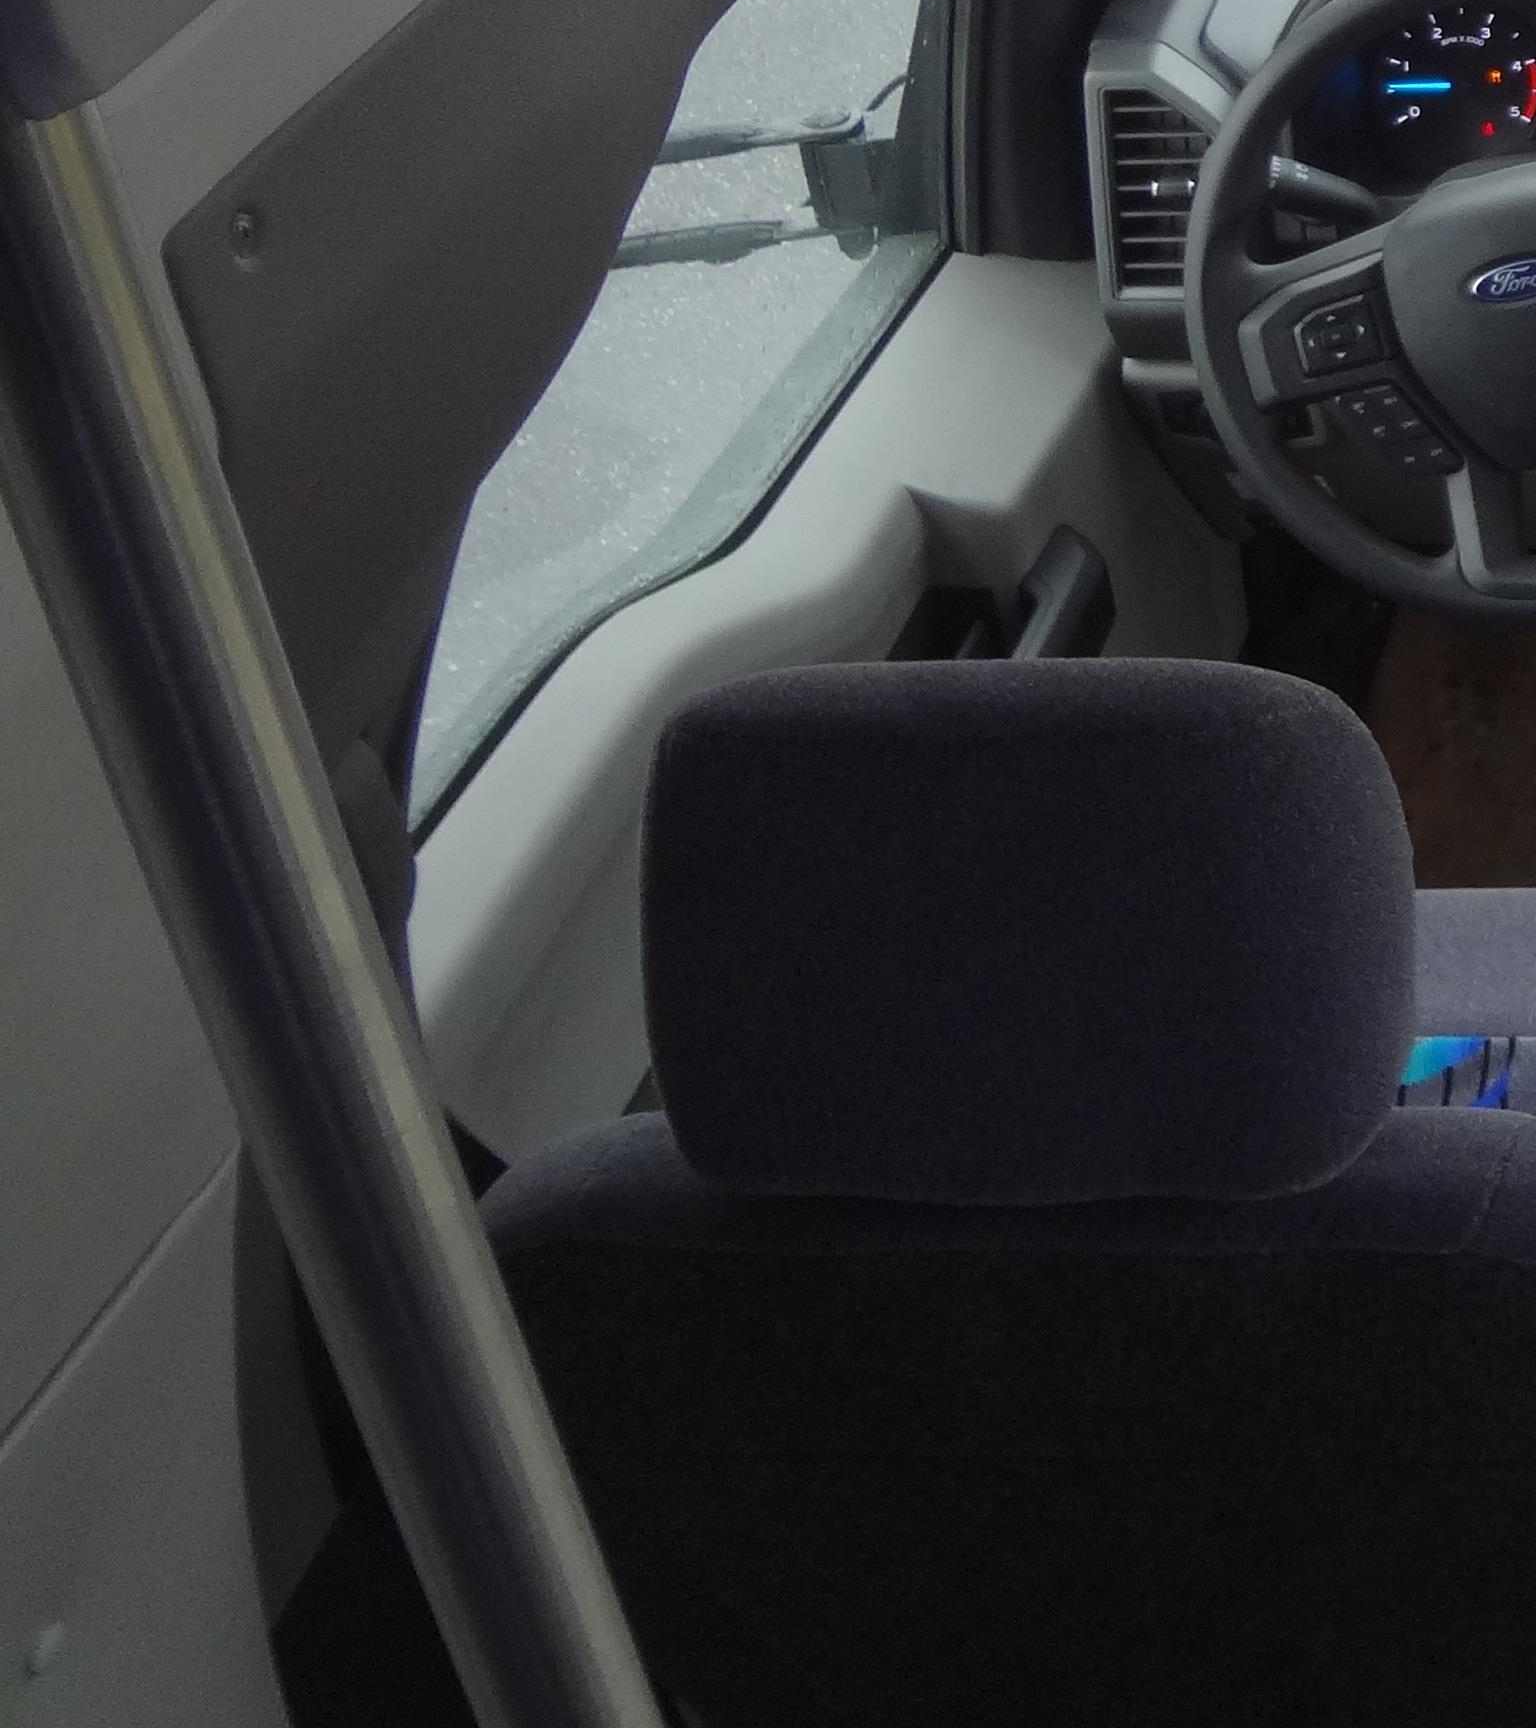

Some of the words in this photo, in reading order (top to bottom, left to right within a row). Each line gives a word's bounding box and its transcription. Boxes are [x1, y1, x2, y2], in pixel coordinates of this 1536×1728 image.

[1433, 27, 1443, 39] 2
[1481, 27, 1491, 39] 3
[1512, 60, 1523, 72] 4
[1409, 106, 1421, 118] 0
[1511, 106, 1521, 117] 5
